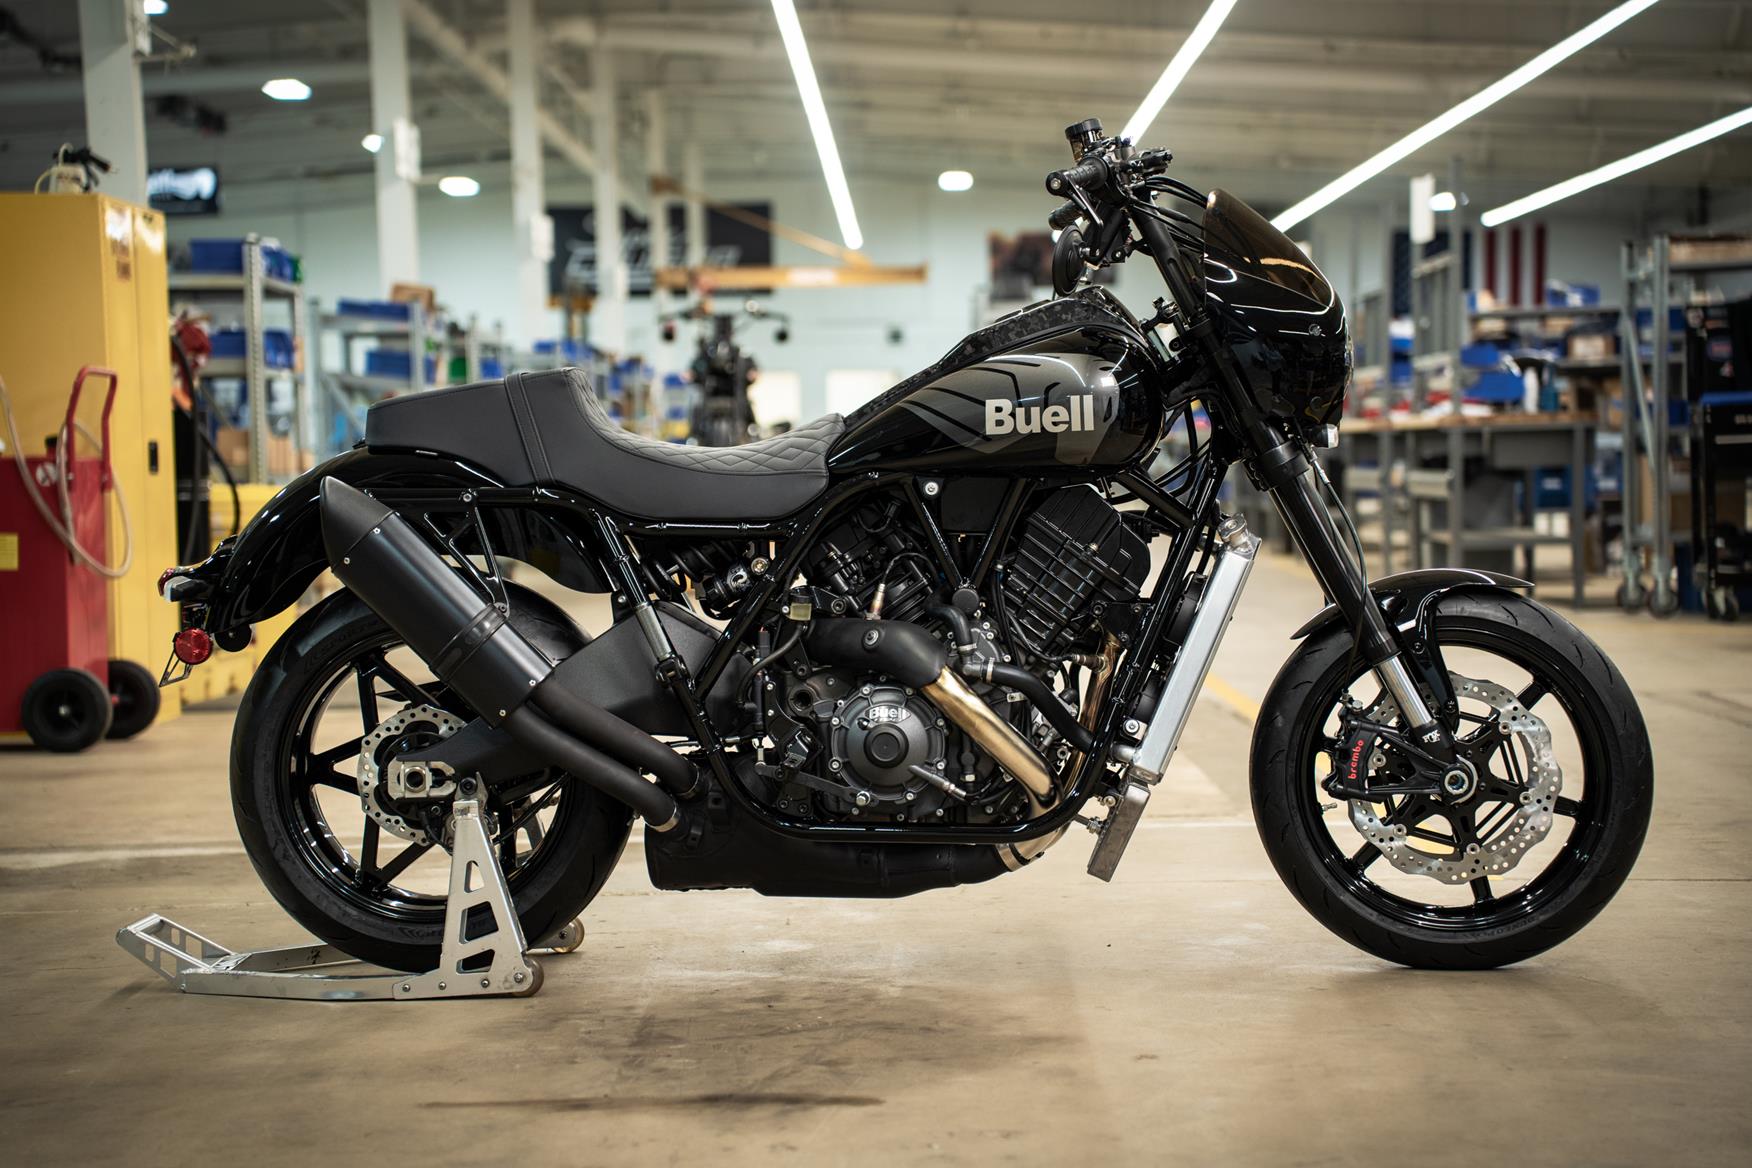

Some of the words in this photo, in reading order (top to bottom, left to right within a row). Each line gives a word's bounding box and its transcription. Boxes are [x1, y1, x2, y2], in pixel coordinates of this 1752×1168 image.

[985, 395, 1095, 435] Buell
[1422, 730, 1441, 743] FOX
[1347, 741, 1364, 779] brembo
